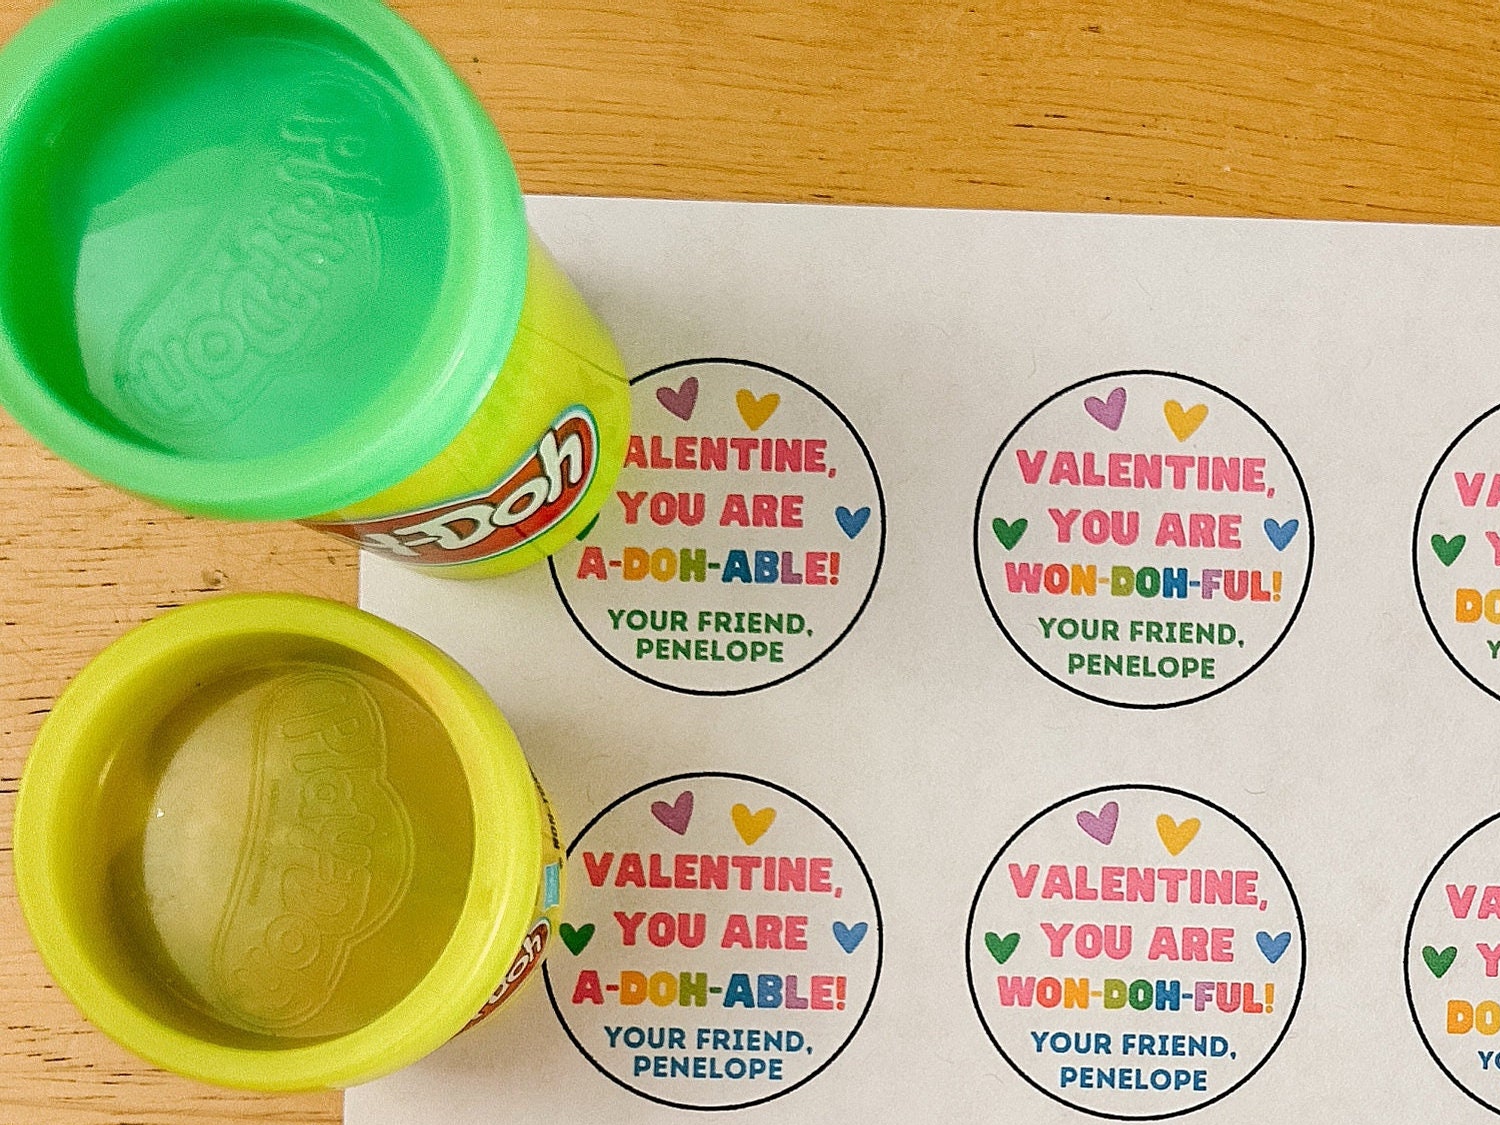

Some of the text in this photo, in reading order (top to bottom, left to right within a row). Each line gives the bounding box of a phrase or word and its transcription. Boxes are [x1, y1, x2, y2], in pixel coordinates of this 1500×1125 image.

[624, 435, 837, 480] ALENTINE,
[1015, 449, 1275, 498] VALENTINE,
[616, 491, 804, 529] YOU ARE
[1047, 508, 1242, 549] YOU ARE
[577, 546, 840, 586] A-DOH-ABLE!
[1004, 562, 1282, 602] WON-DOH-FUL!
[607, 609, 813, 637] YOUR FRIEND,
[1038, 617, 1244, 648] YOUR FRIEND,
[636, 638, 783, 663] PENELOPE
[1068, 653, 1215, 679] PENELOPE
[581, 851, 842, 898] VALENTINE,
[1008, 863, 1268, 911] VALENTINE,
[612, 911, 808, 951] YOU ARE
[1040, 923, 1235, 963] YOU ARE
[570, 969, 846, 1011] A-DOH-ABLE!
[998, 976, 1276, 1014] WON-DOH-FUL!
[604, 1026, 813, 1055] YOUR FRIEND,
[1030, 1031, 1237, 1060] YOUR FRIEND,
[633, 1055, 783, 1081] PENELOPE
[1060, 1066, 1207, 1092] PENELOPE
